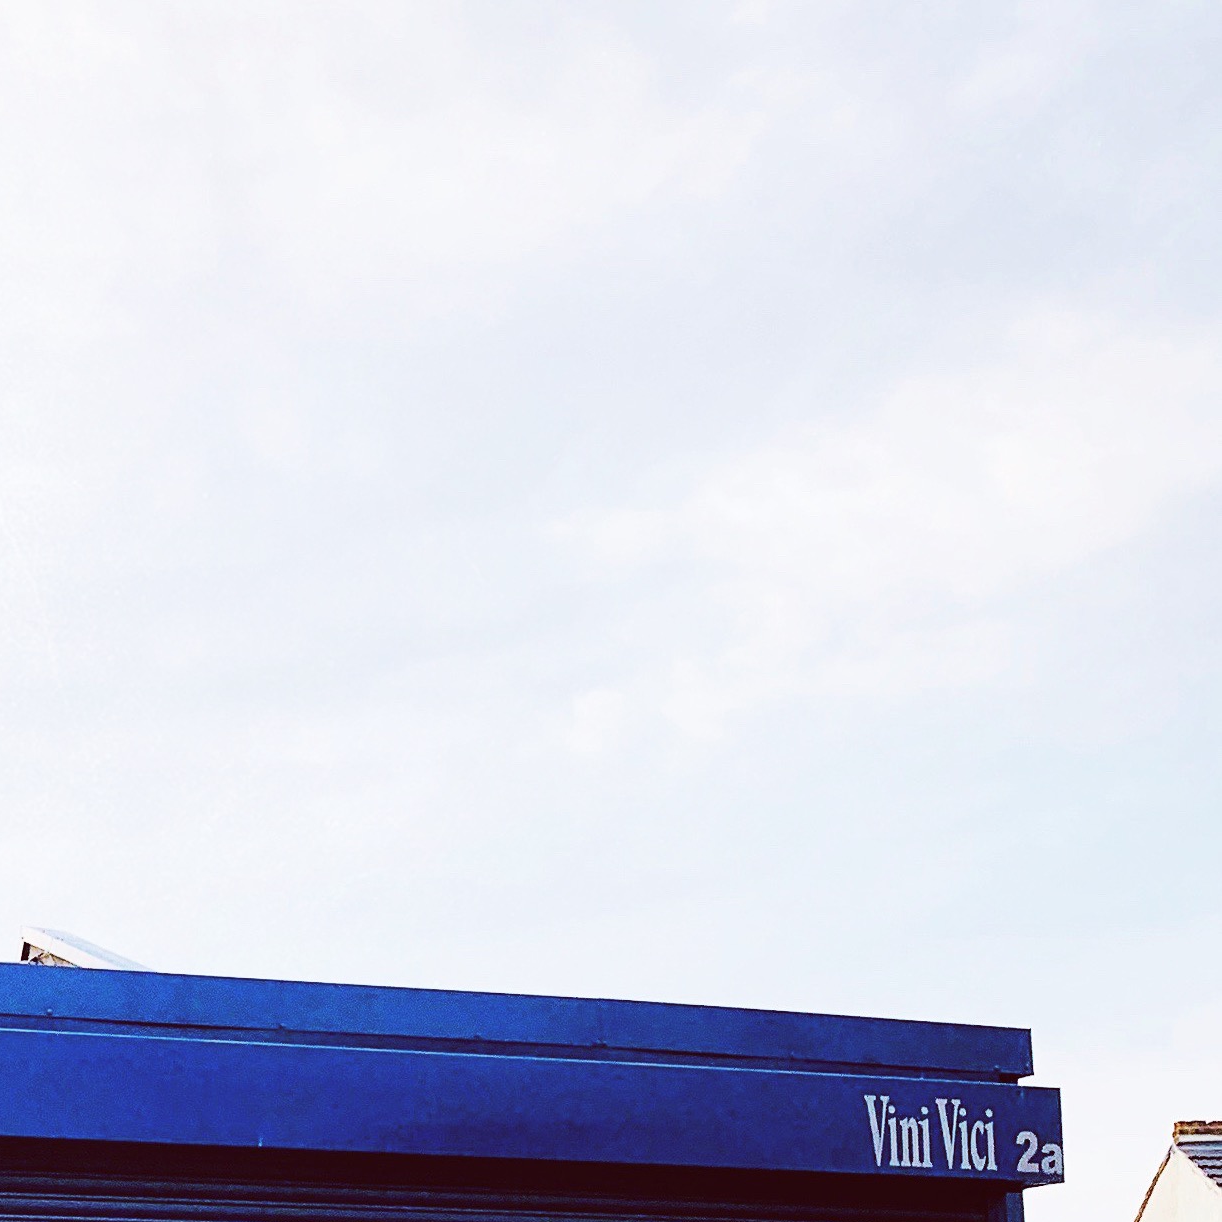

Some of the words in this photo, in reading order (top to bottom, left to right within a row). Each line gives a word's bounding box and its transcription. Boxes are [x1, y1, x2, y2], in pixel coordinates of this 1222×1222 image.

[864, 1094, 934, 1168] Vini
[935, 1098, 998, 1171] Vici
[1016, 1131, 1063, 1175] 2a
